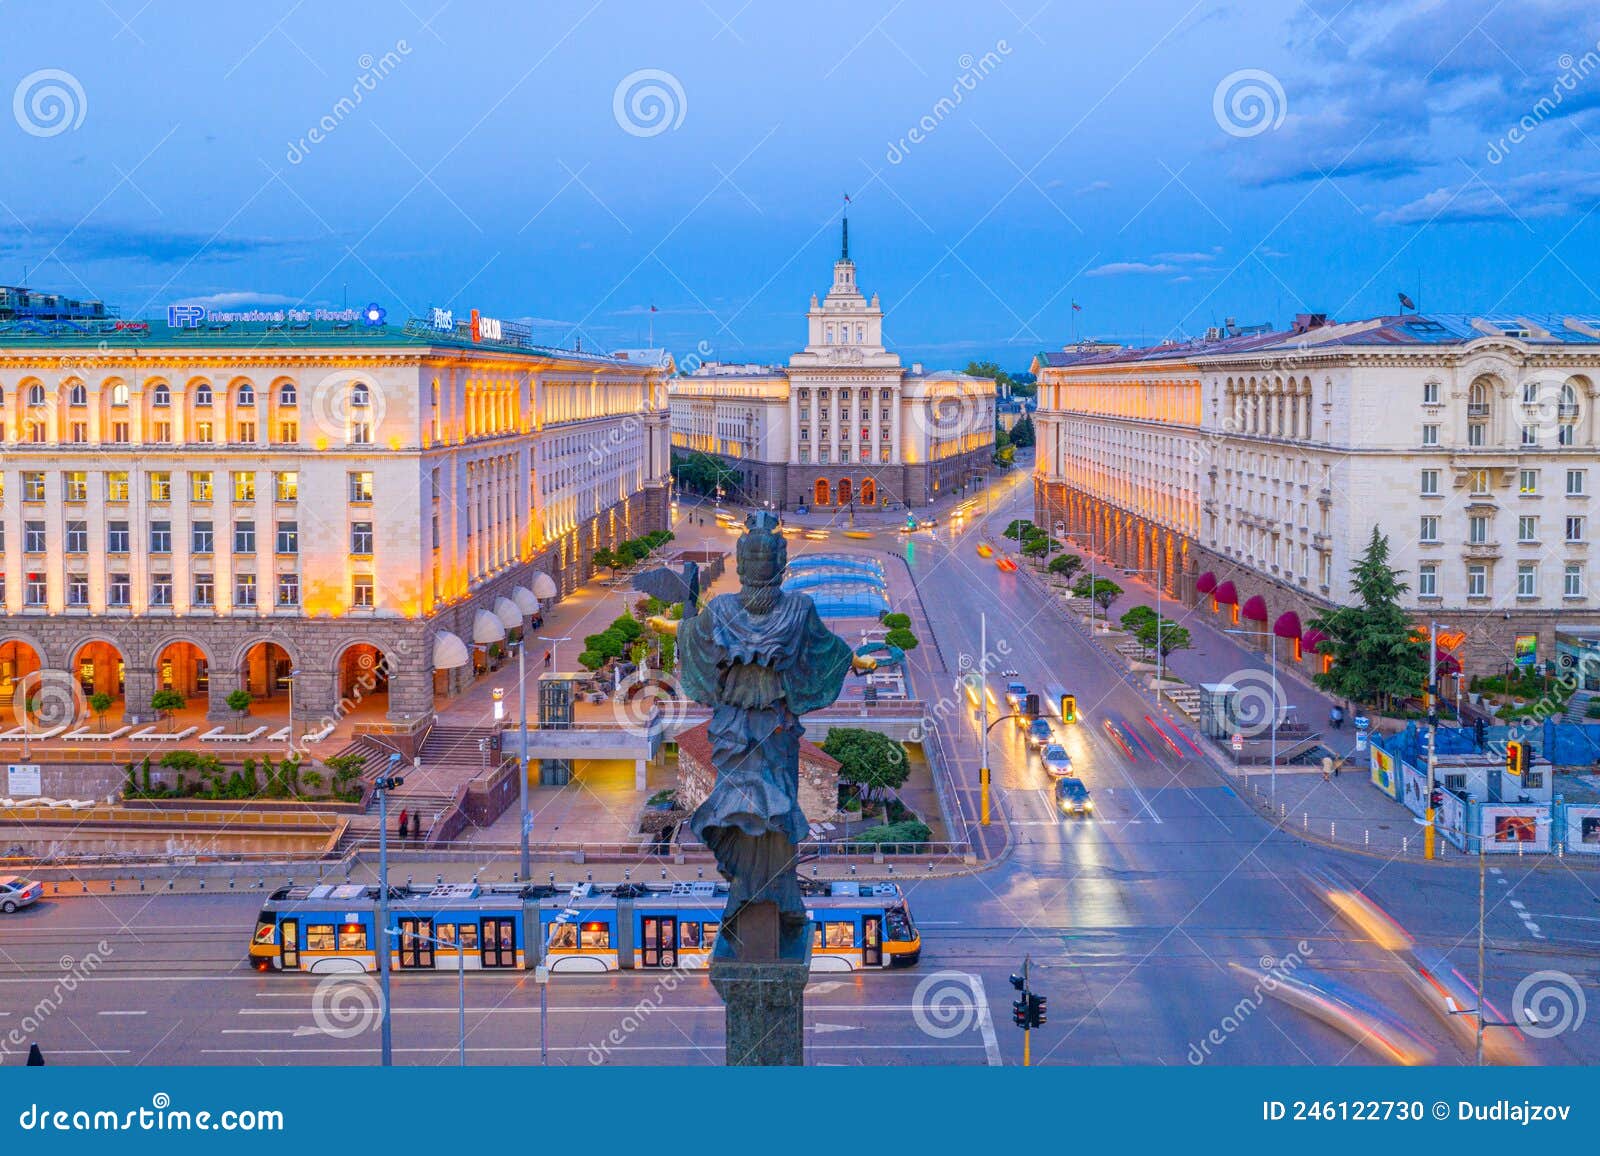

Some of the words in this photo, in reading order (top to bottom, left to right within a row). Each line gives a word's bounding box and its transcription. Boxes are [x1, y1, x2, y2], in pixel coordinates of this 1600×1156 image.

[167, 305, 206, 328] IFP
[207, 309, 284, 322] International
[288, 309, 312, 322] Fair
[315, 308, 361, 321] Plovdiv
